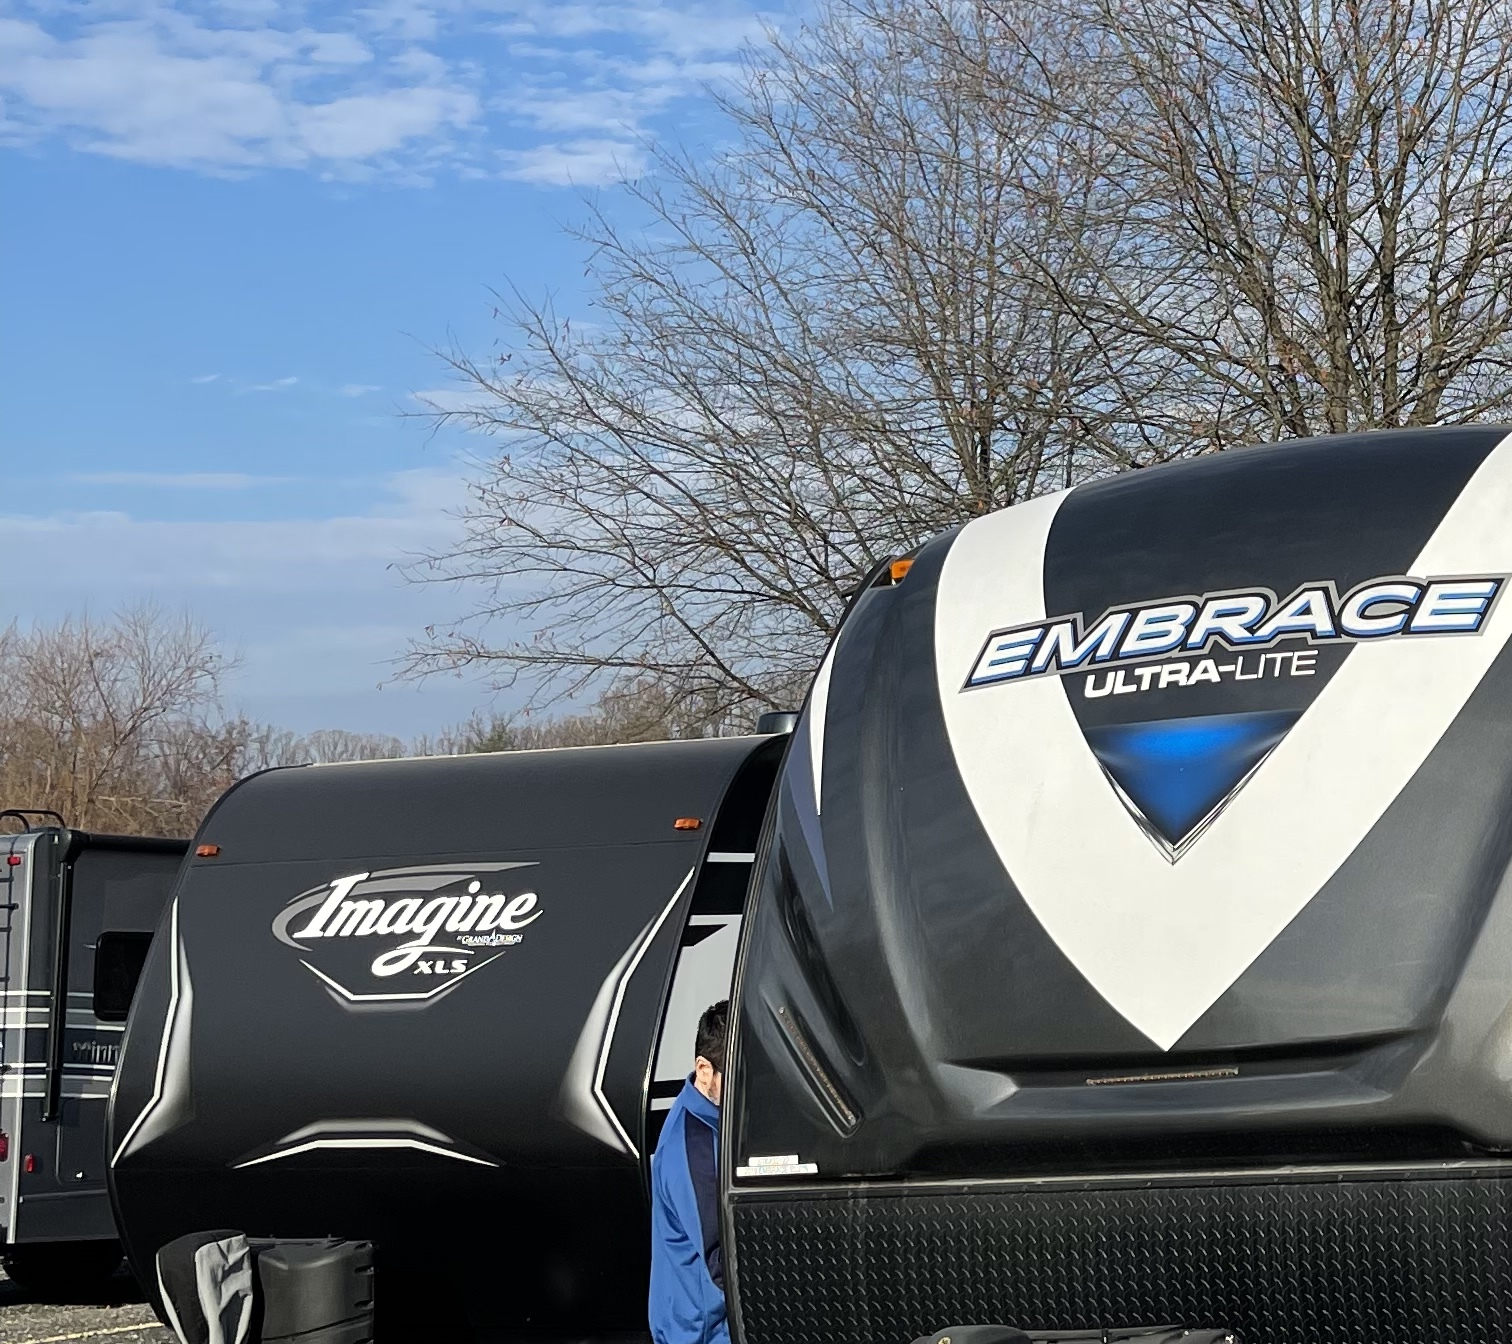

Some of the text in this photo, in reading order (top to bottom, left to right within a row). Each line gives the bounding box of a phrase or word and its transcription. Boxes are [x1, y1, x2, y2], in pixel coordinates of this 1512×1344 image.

[968, 576, 1506, 689] EMBRACE
[1083, 650, 1318, 699] ULTRA-LITE
[292, 872, 544, 976] Imagine
[413, 959, 468, 974] XLS
